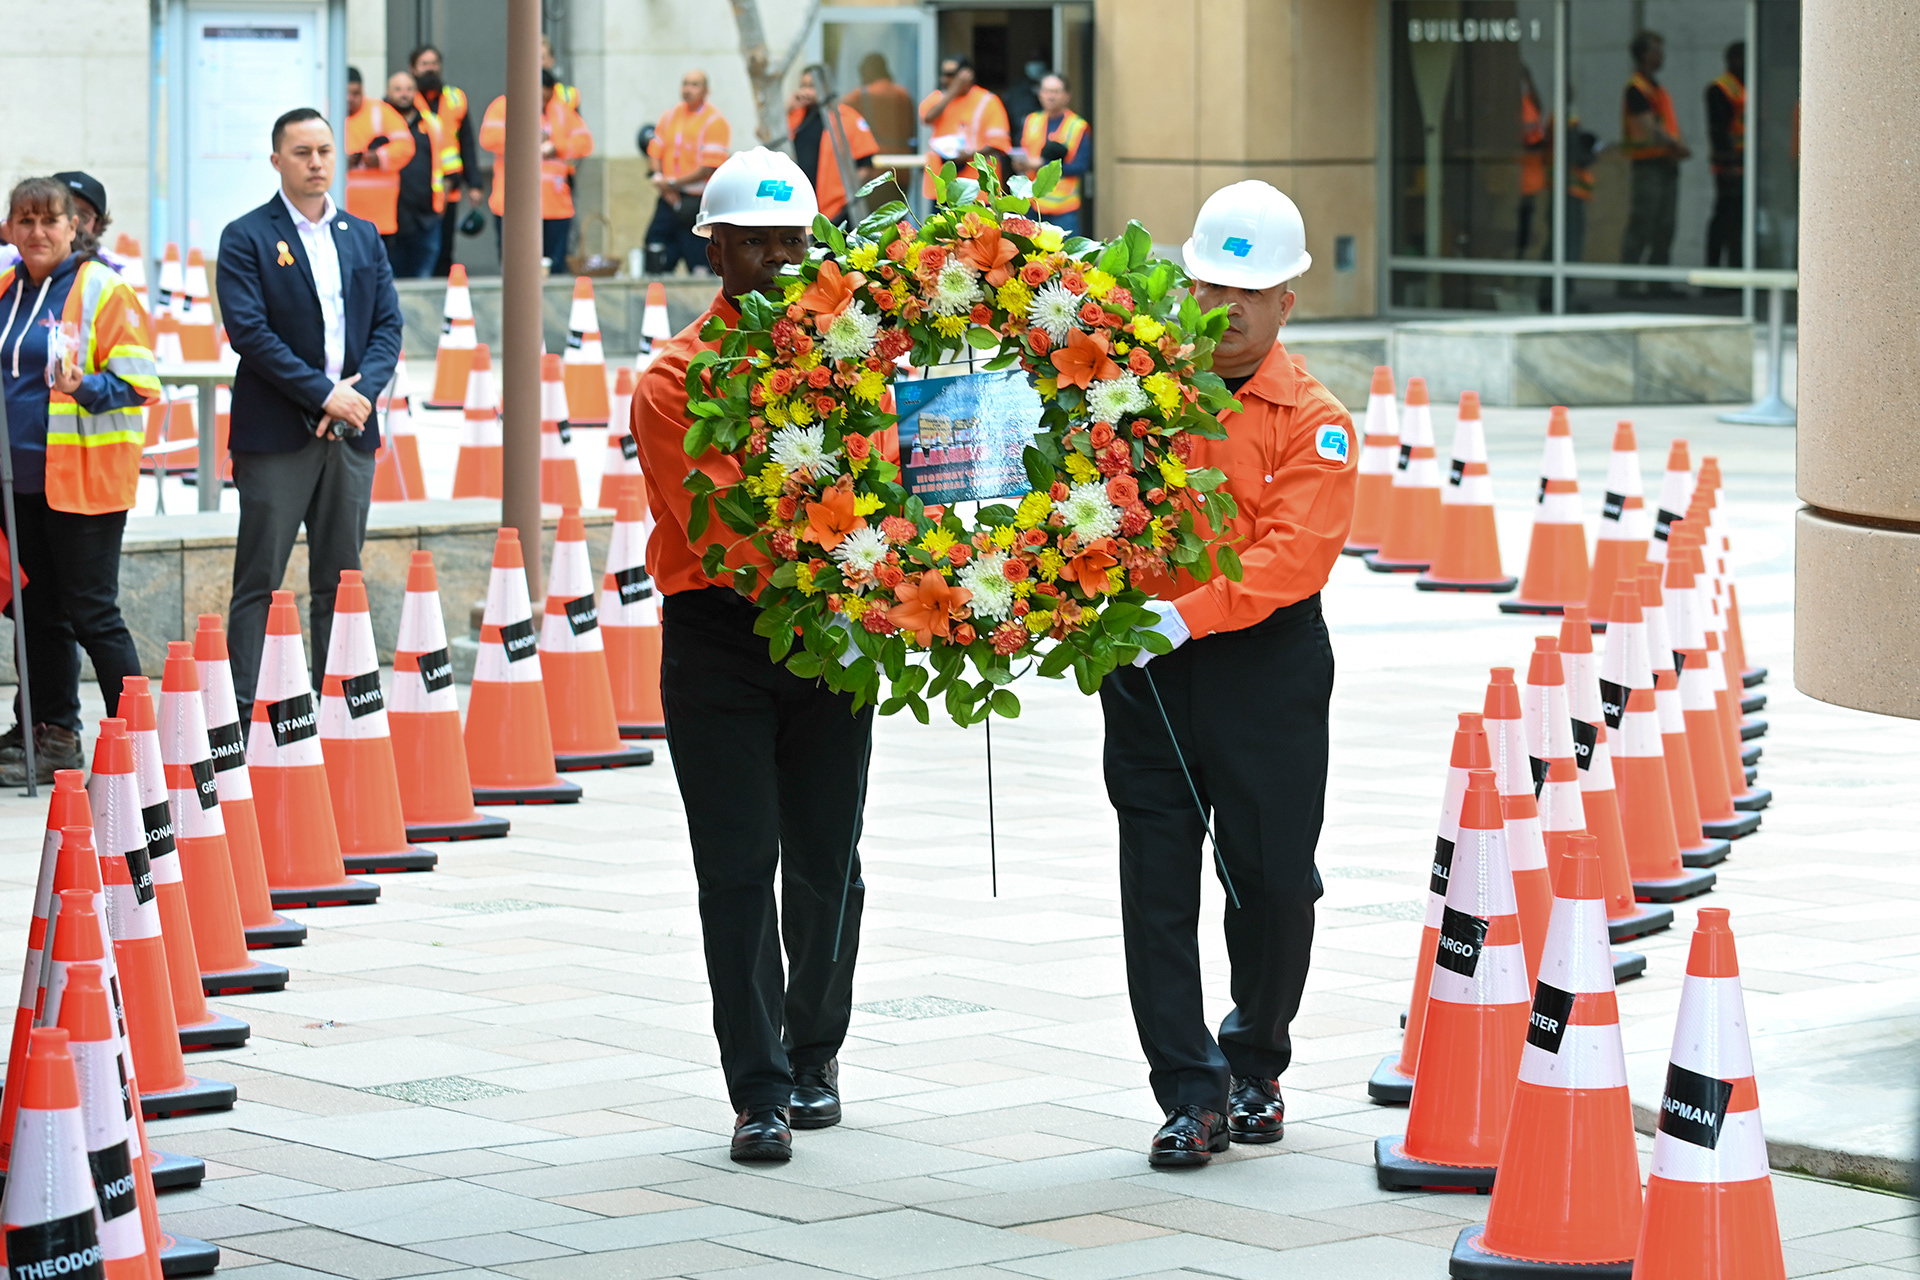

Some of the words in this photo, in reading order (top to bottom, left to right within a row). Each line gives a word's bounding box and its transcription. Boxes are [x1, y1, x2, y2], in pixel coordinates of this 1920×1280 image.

[1408, 18, 1522, 42] BUILDING
[1530, 18, 1541, 42] 1
[916, 471, 964, 484] HIGHWAY
[912, 480, 967, 493] MEMORIAL
